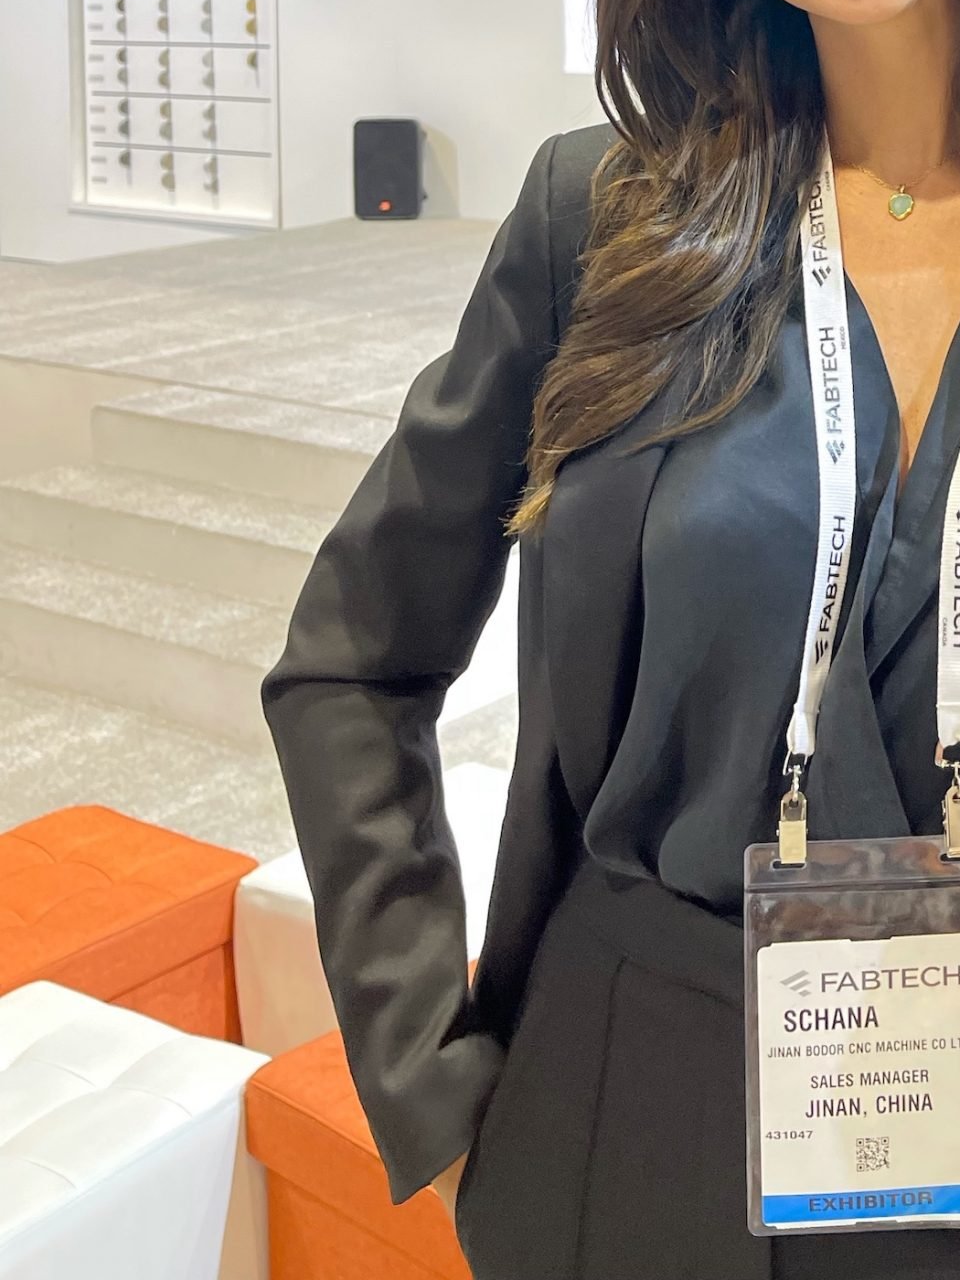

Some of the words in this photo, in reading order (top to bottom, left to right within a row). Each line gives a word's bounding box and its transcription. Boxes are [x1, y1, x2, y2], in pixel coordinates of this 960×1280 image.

[818, 326, 842, 434] FABTECH
[818, 515, 846, 633] FABTECH
[784, 1005, 879, 1033] SCHANA
[767, 1046, 801, 1058] JINAN
[806, 1043, 844, 1056] BODOR
[849, 1041, 871, 1054] CNC
[876, 1038, 928, 1053] MACHINE
[932, 1038, 946, 1050] CO
[810, 1073, 854, 1089] SALES
[860, 1069, 929, 1086] MANAGER
[805, 1097, 867, 1118] JINAN,
[875, 1093, 933, 1115] CHINA
[765, 1130, 813, 1140] 431047
[808, 1191, 934, 1213] EXHIBITOR
